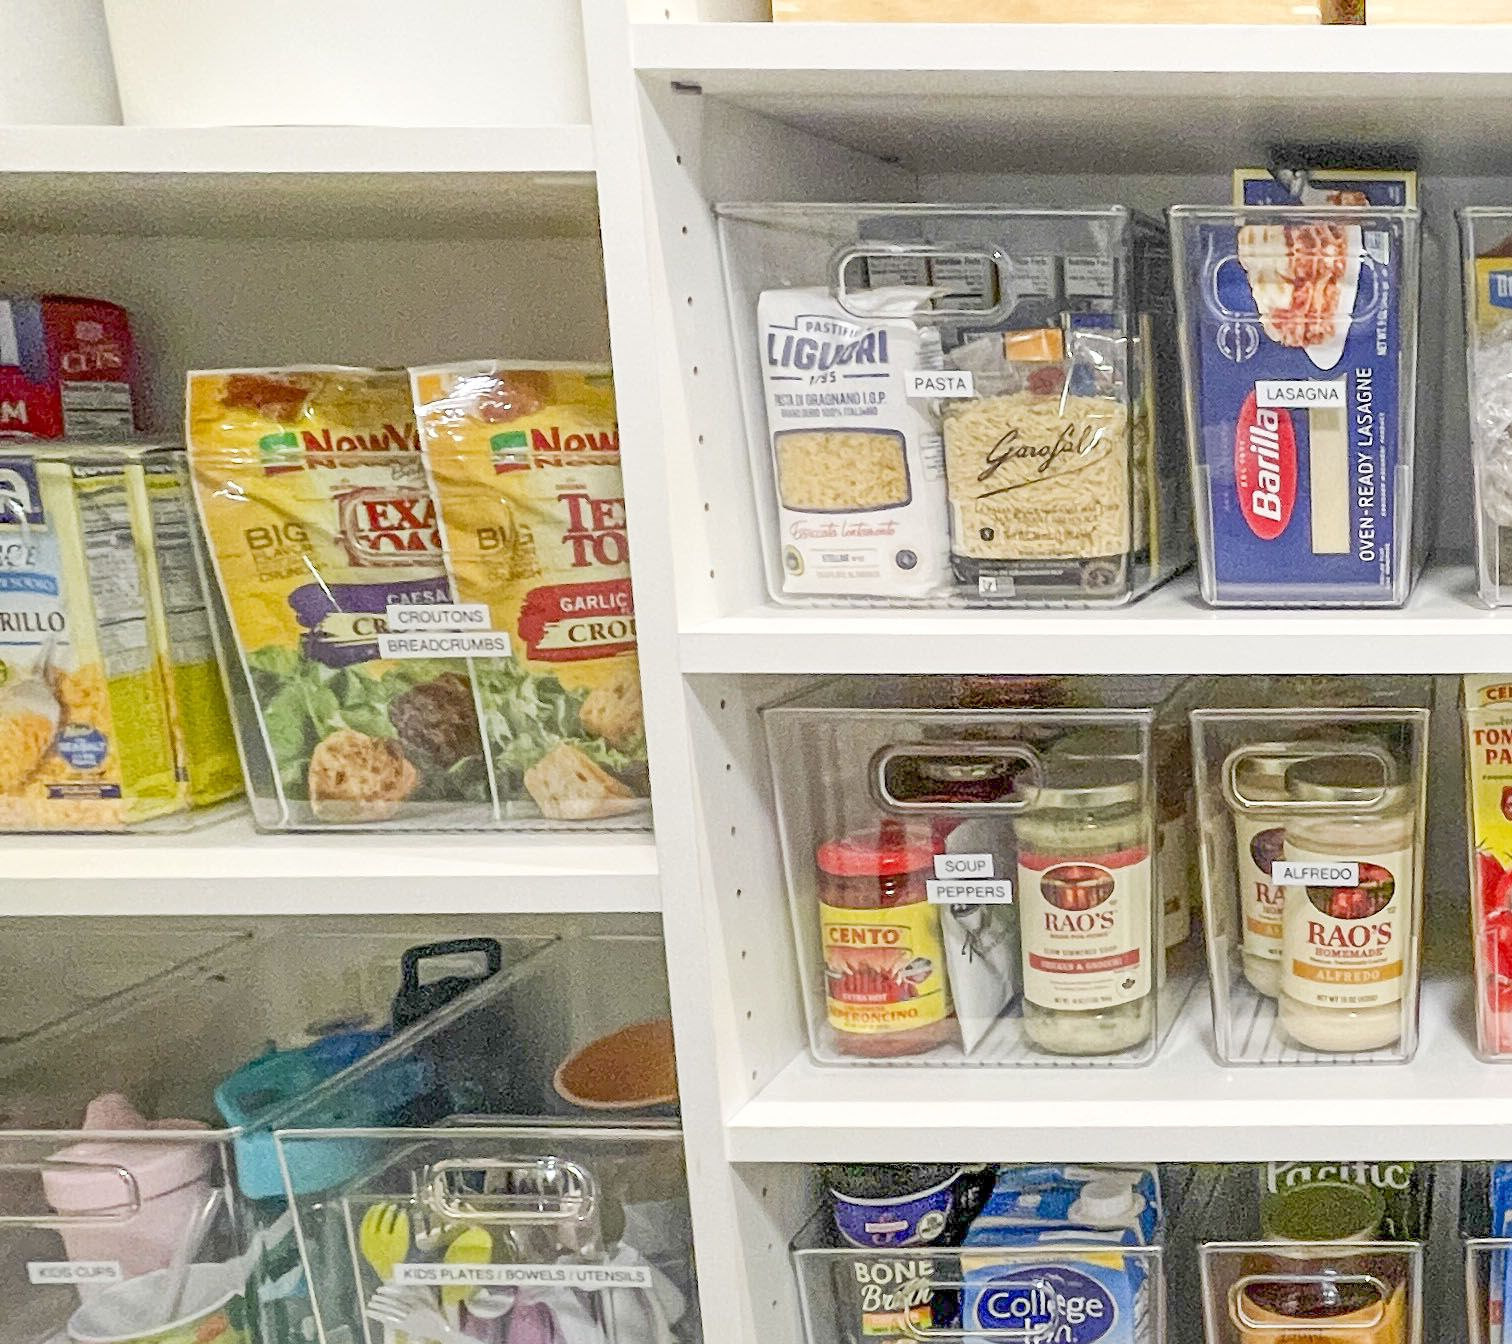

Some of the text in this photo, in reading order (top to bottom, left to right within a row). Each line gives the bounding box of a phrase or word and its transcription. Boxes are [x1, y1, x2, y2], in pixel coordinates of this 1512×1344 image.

[767, 329, 889, 372] LIGUORI
[914, 377, 967, 391] PASTA
[1266, 387, 1340, 401] LASAGNA
[1250, 409, 1282, 522] Barilla
[1355, 366, 1375, 562] OVEN-READY LASAGNE
[245, 523, 309, 550] BIG
[477, 524, 534, 551] BIG
[559, 592, 629, 613] GARLIC
[398, 610, 484, 625] CROUTONS
[387, 638, 506, 653] BREADCRUMBS
[944, 860, 987, 873] SOUP
[1283, 867, 1352, 881] ALFREDO
[936, 885, 1006, 899] PEPPERS
[1045, 911, 1115, 933] RAO'S
[829, 927, 900, 946] CENTO
[1307, 921, 1392, 948] RAO'S
[1315, 947, 1385, 958] HOMEMADE
[1316, 969, 1381, 981] ALFREDO
[37, 1264, 117, 1280] KIDS CUPS
[403, 1266, 645, 1283] KIDS PLATES BOWELS UTENSILS
[854, 1259, 936, 1286] BONE
[860, 1280, 936, 1312] Broth
[987, 1291, 1104, 1319] College
